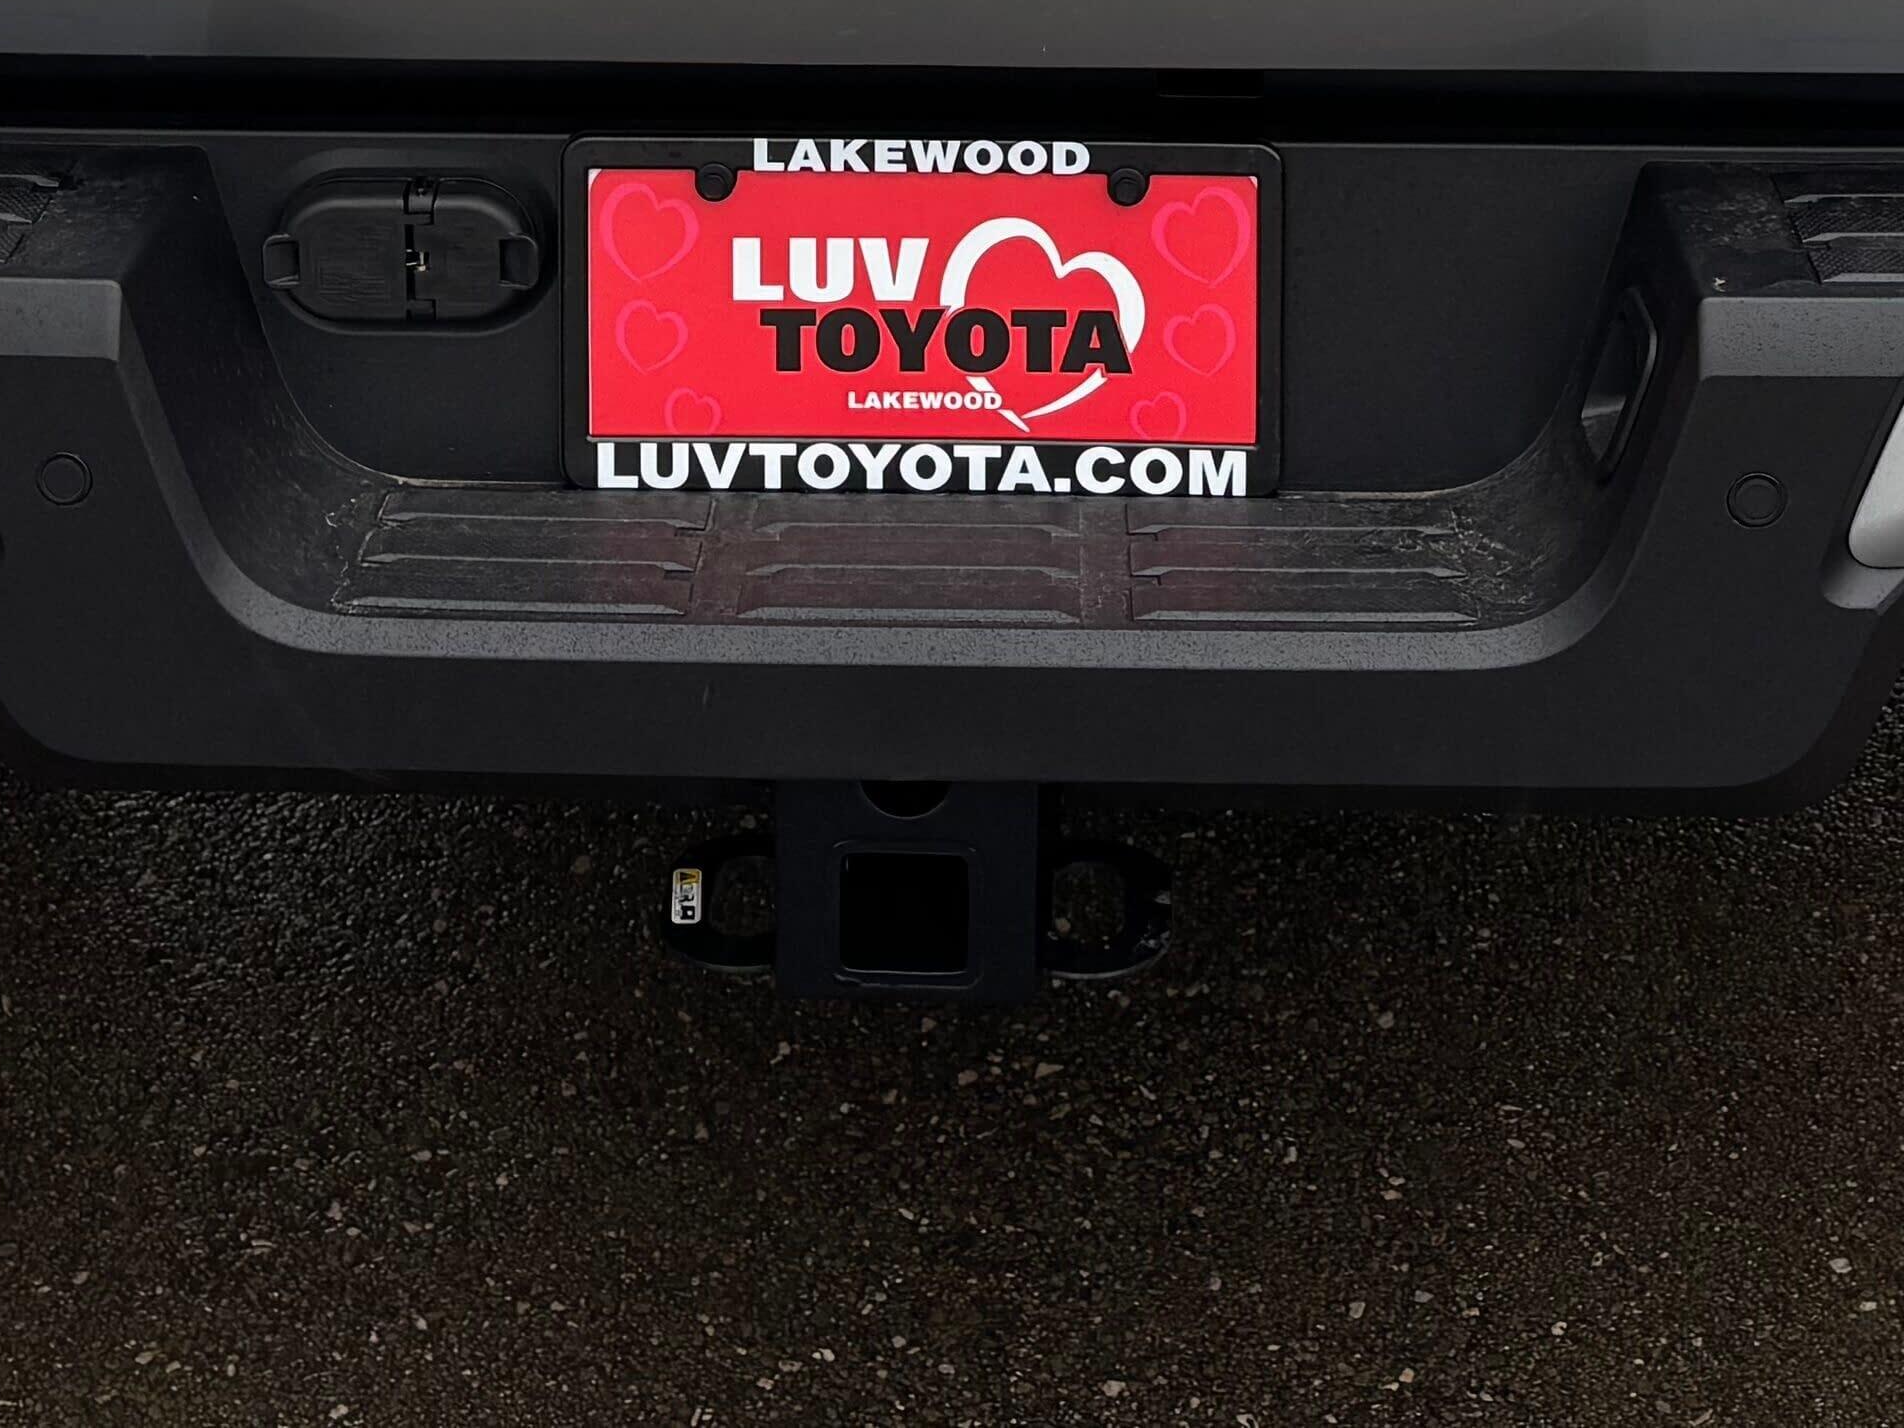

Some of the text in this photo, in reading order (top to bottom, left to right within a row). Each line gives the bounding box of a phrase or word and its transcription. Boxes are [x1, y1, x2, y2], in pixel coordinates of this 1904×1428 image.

[752, 138, 1091, 176] LAKEWOOD
[732, 236, 930, 302] LUV
[758, 307, 1134, 375] TOYOTA
[847, 390, 1003, 411] LAKEWOOD
[596, 442, 1248, 497] LUVTOYOTA.COM
